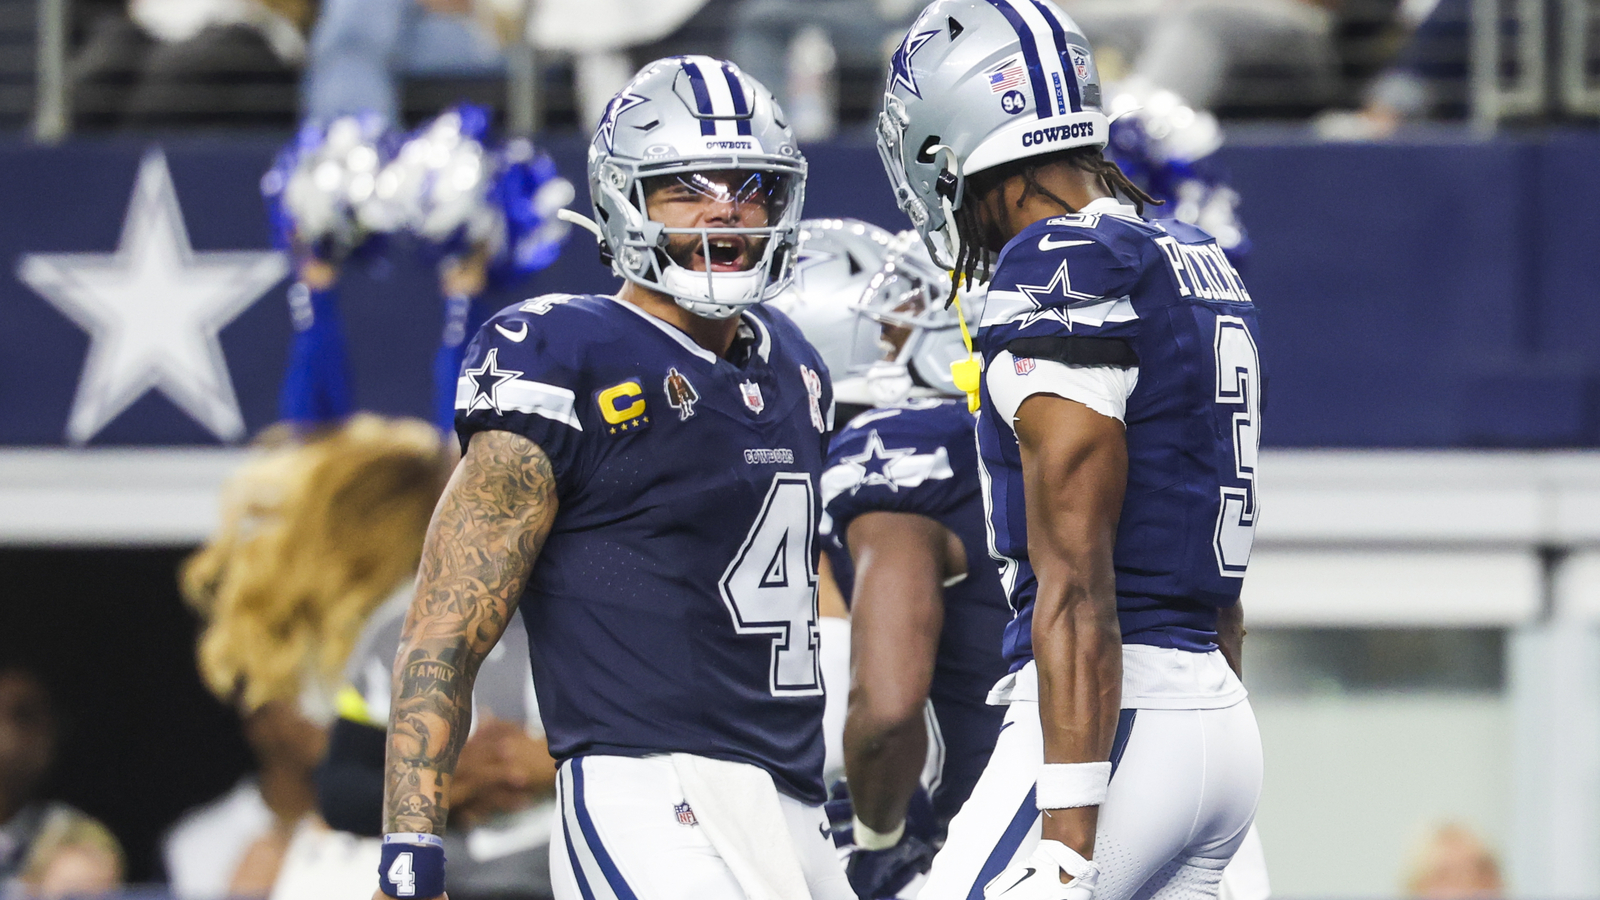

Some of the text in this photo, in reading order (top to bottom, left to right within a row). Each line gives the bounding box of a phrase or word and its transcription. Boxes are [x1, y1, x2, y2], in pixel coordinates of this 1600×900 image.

[1002, 93, 1024, 112] 94
[1021, 121, 1094, 148] COWBOYS
[1016, 358, 1035, 374] NFL
[597, 381, 647, 425] C
[743, 448, 794, 465] COWBOYS
[1212, 314, 1262, 579] 3
[717, 471, 825, 698] 4
[409, 664, 460, 682] FAMILY
[387, 851, 416, 897] 4
